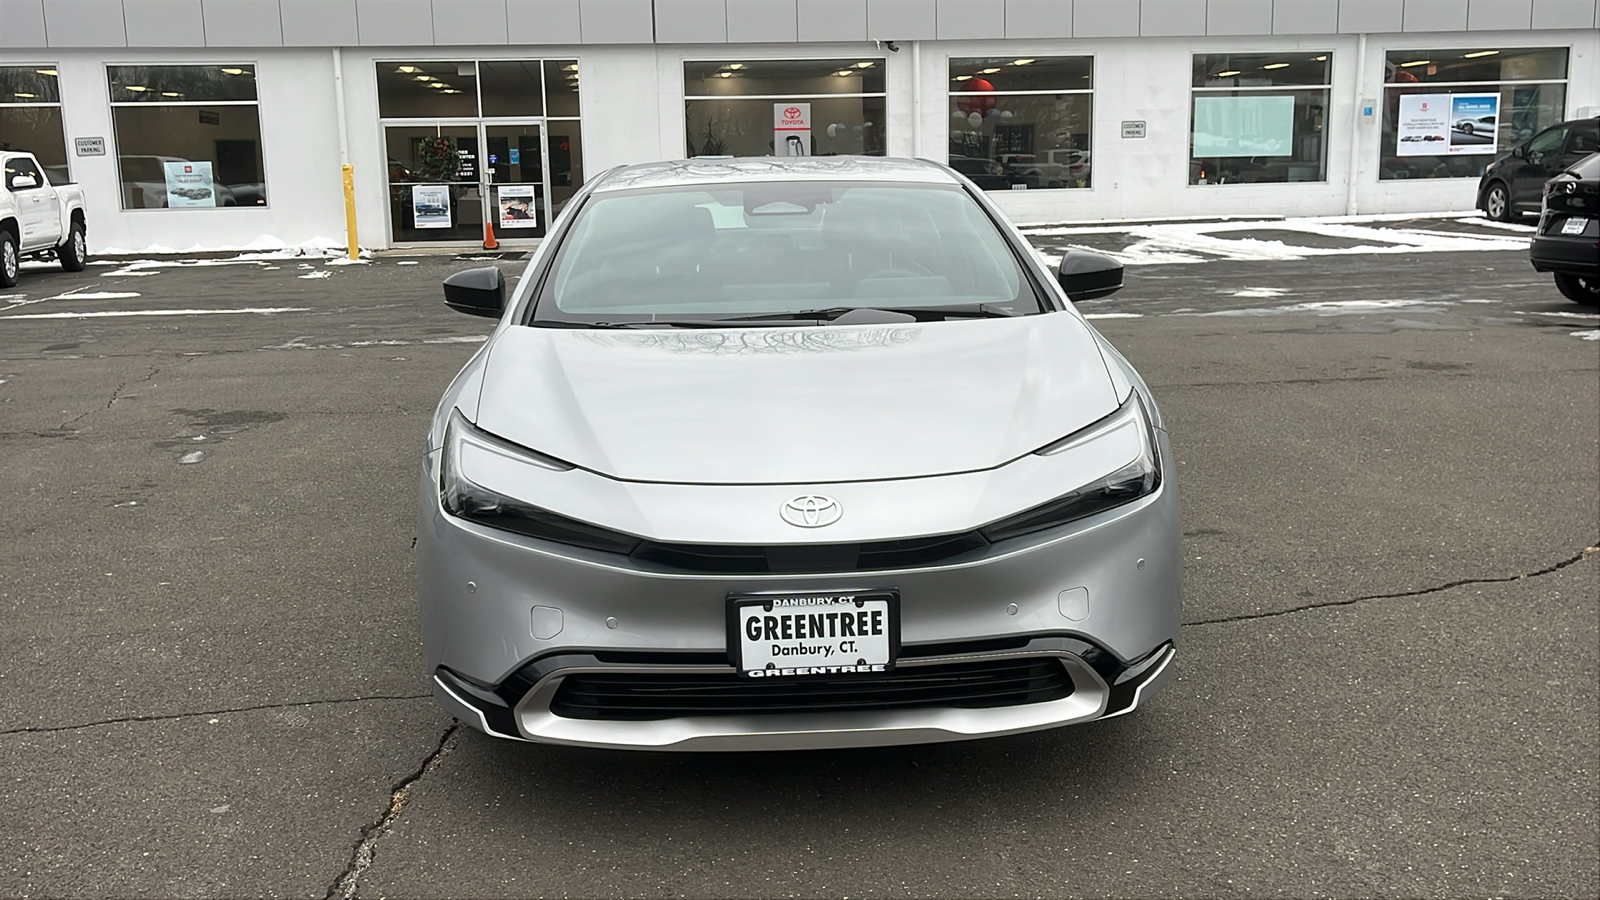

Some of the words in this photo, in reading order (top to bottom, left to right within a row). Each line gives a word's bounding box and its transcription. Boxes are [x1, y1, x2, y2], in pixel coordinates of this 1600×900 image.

[772, 597, 835, 608] DANBURY,
[746, 610, 883, 642] GREENTREE
[772, 642, 835, 657] Danbury,
[840, 641, 858, 653] CT.
[748, 664, 886, 678] GREENTREE
